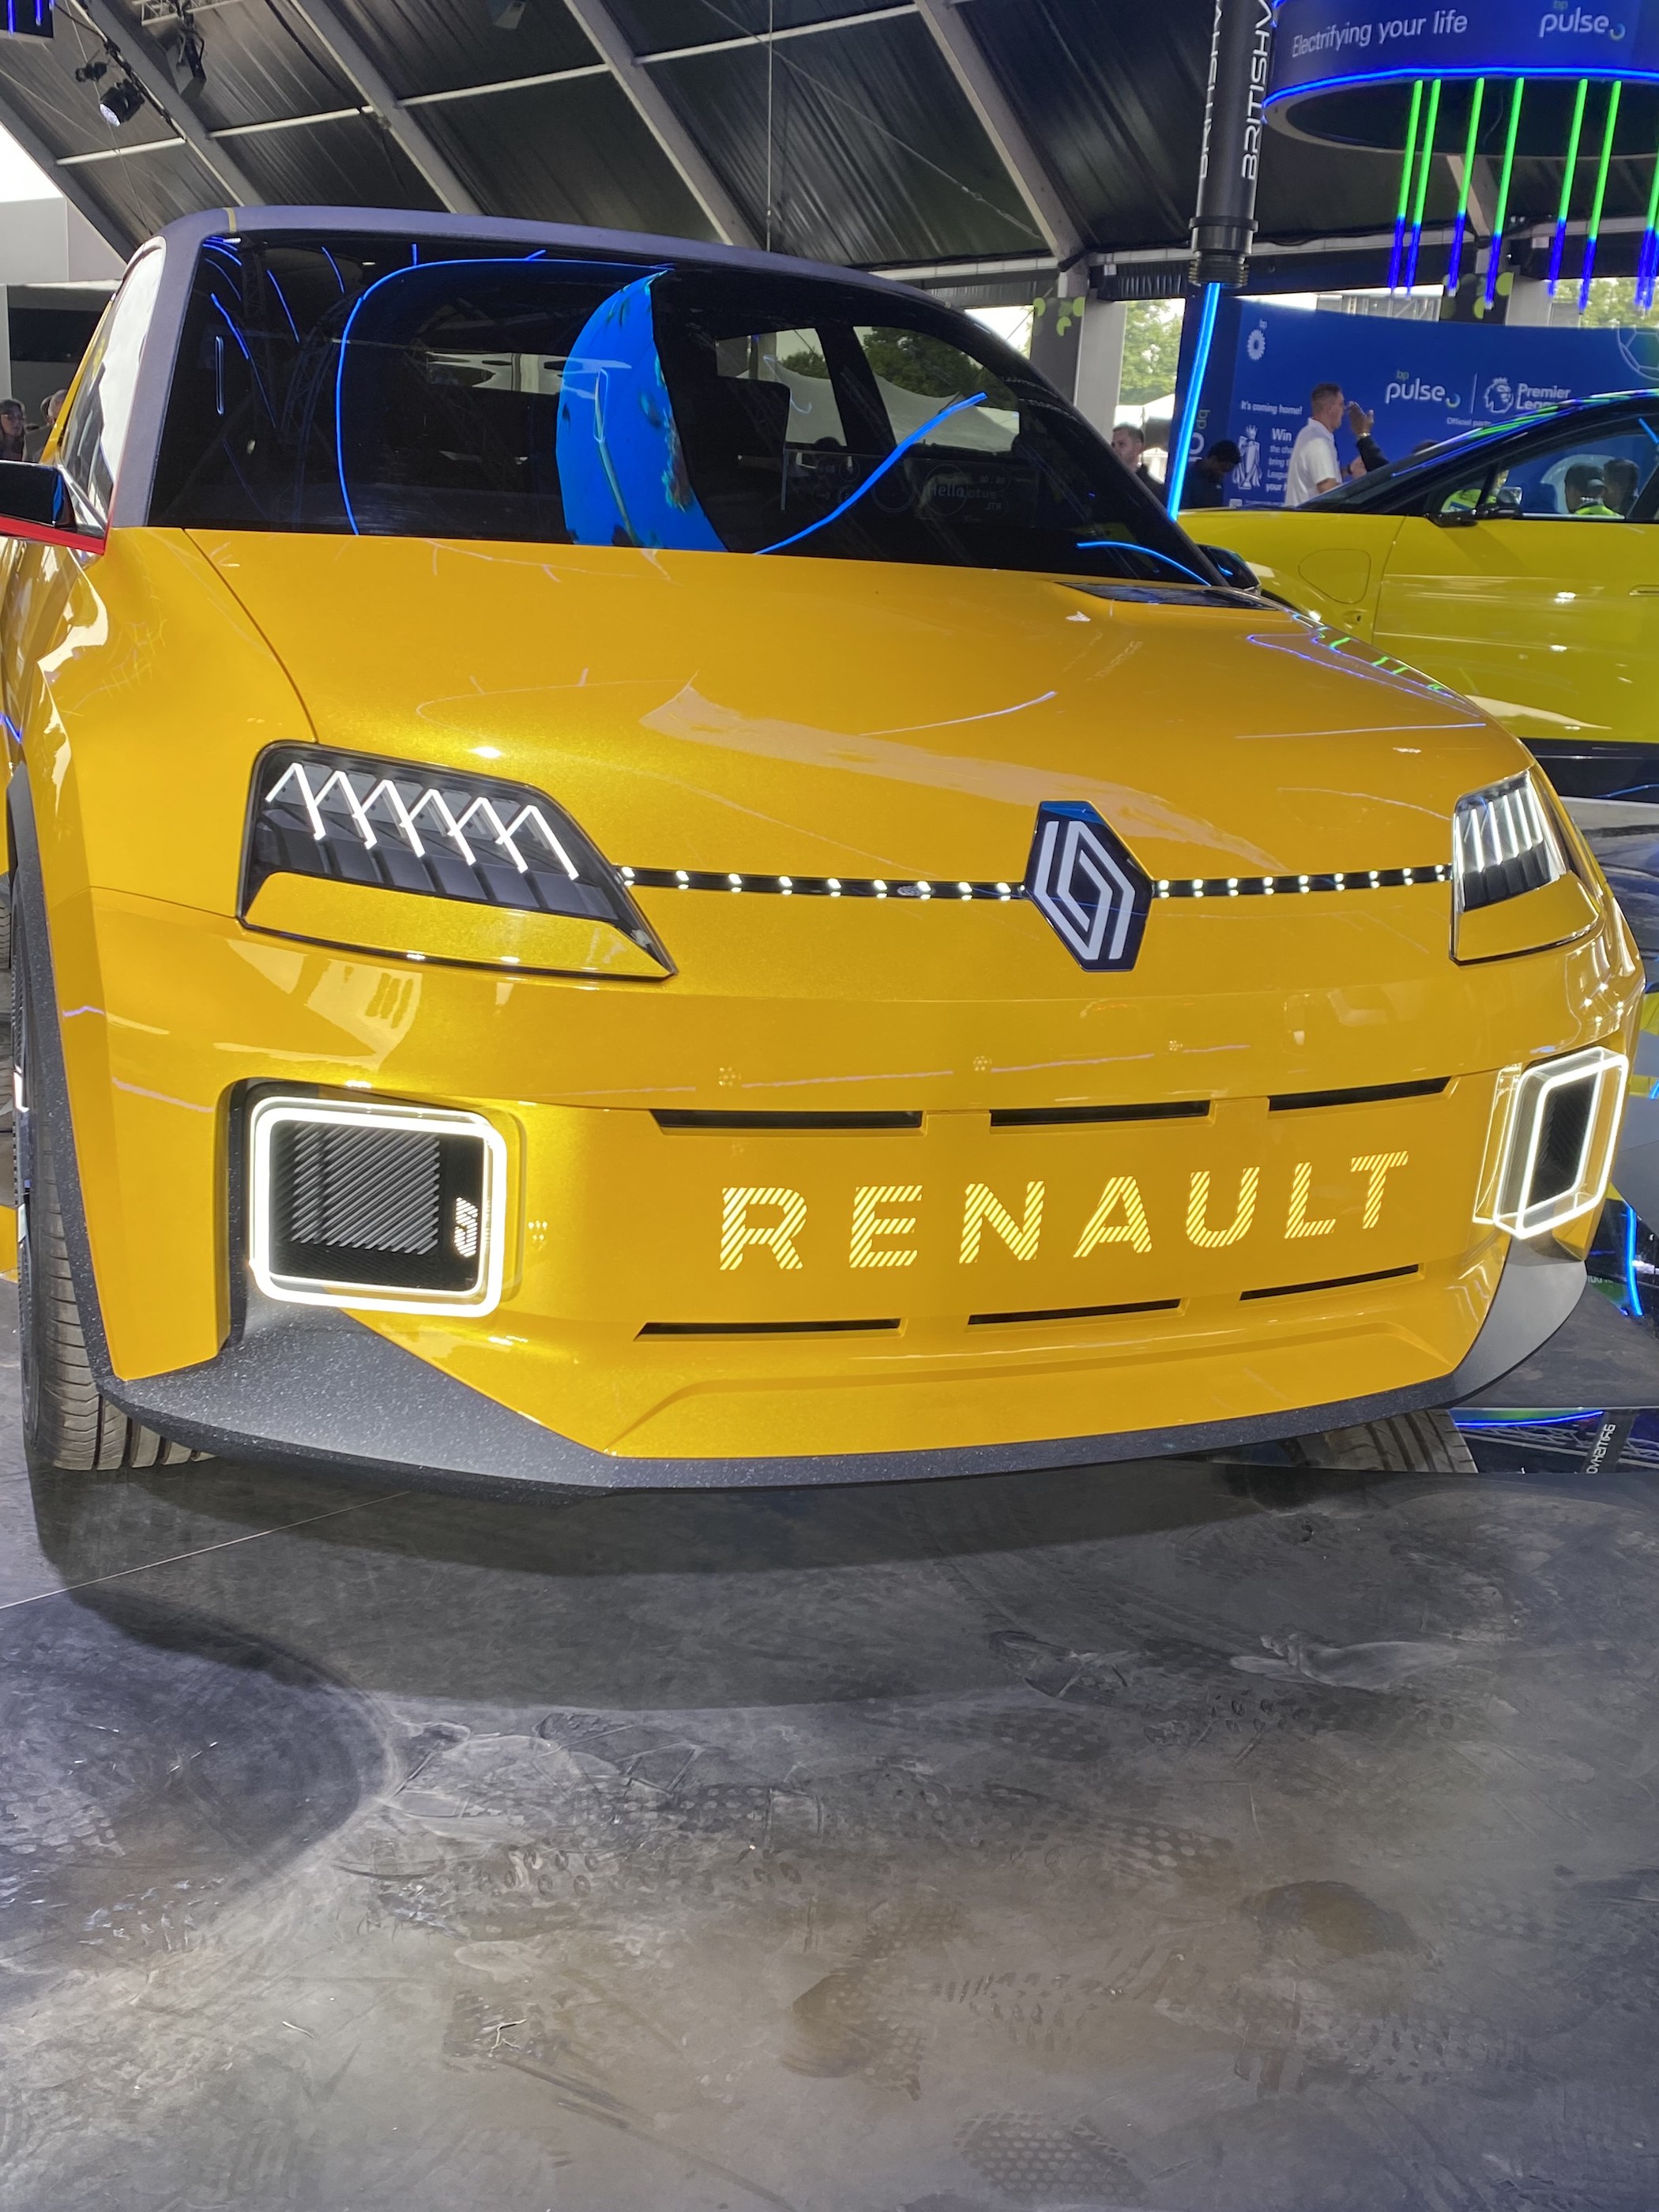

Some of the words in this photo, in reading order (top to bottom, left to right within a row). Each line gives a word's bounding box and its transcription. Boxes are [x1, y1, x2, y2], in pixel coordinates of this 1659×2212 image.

[1539, 6, 1610, 38] pulse
[1292, 22, 1372, 58] Electrifying
[1378, 17, 1428, 44] your
[1432, 9, 1468, 35] life
[1385, 377, 1446, 404] pulse
[1517, 382, 1572, 400] Premier
[1240, 400, 1251, 411] It's
[1252, 403, 1278, 415] coming
[1279, 404, 1303, 415] home!
[1446, 416, 1473, 427] Official
[1271, 427, 1293, 442] Win
[719, 1150, 1409, 1272] RENAULT
